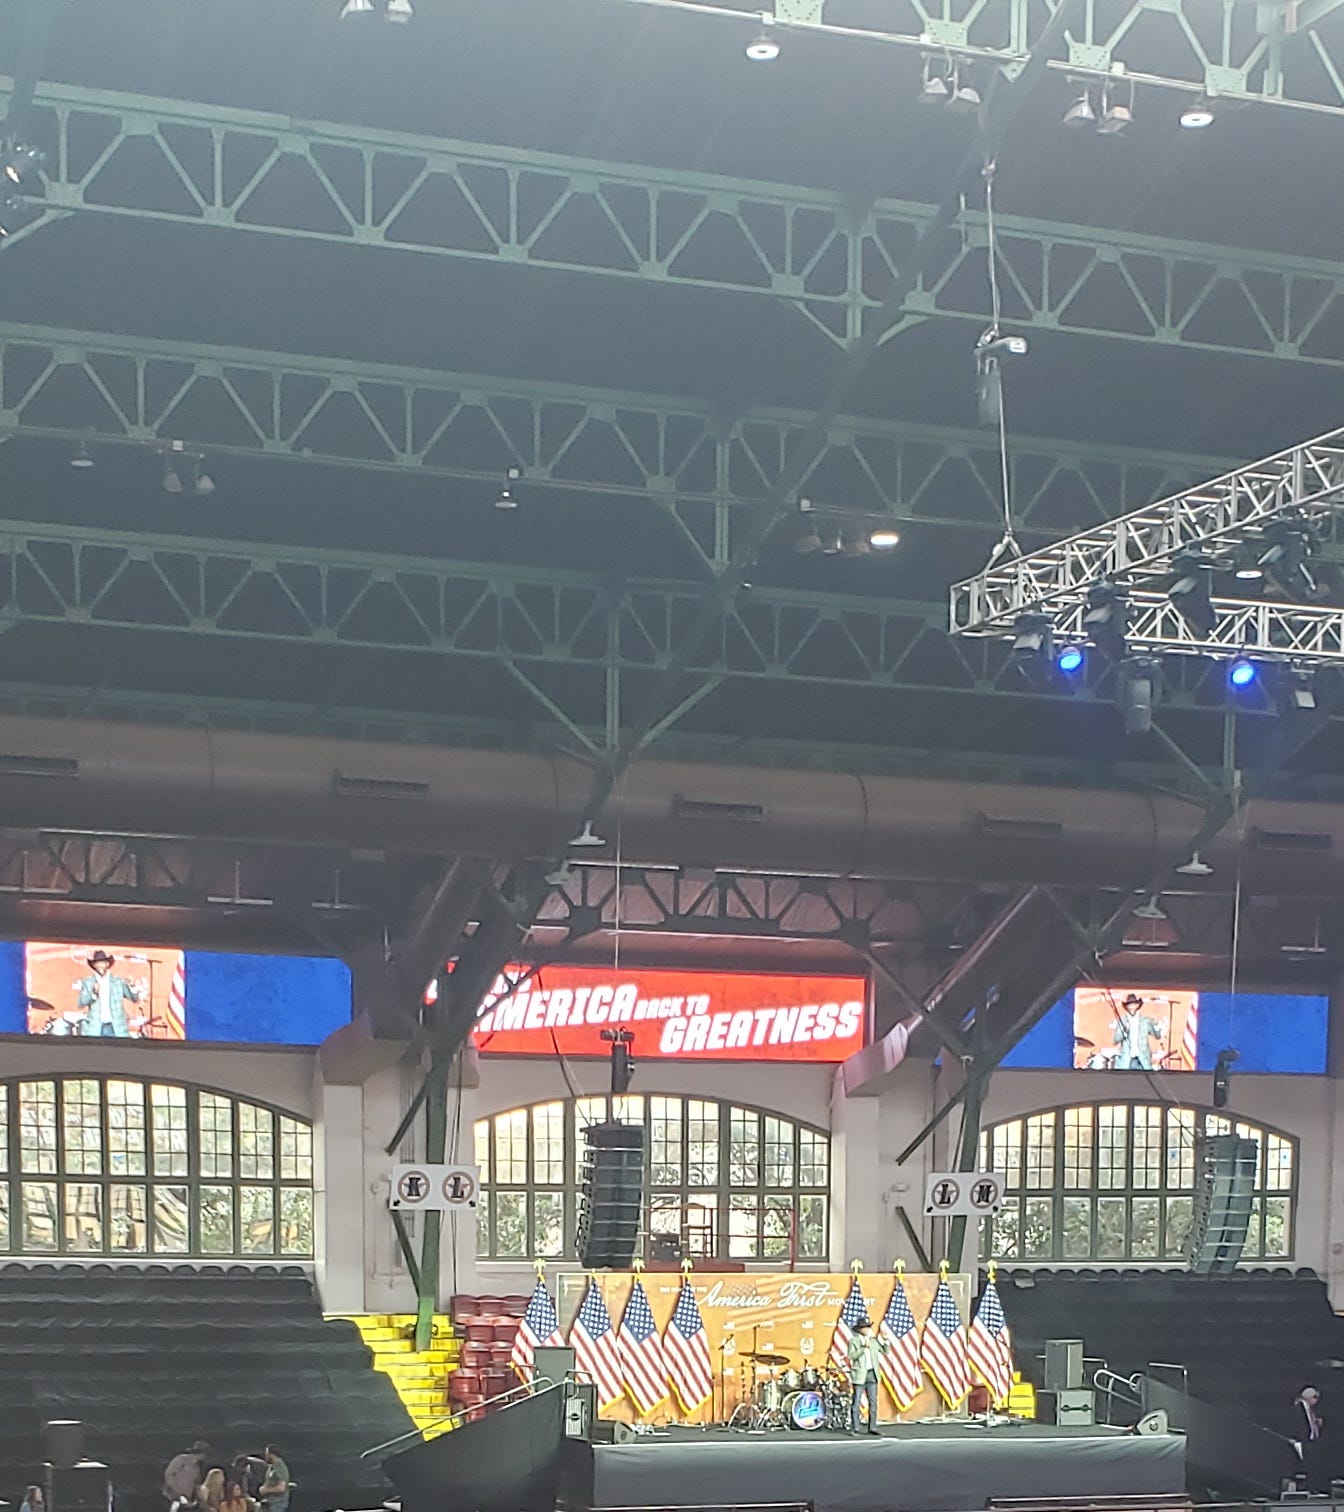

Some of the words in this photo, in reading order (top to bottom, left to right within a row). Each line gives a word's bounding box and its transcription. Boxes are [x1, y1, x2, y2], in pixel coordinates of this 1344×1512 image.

[635, 996, 684, 1020] BACK
[685, 994, 710, 1014] TO
[660, 1001, 862, 1053] GREATNESS
[451, 1177, 465, 1199] L
[939, 1184, 951, 1204] L
[700, 1280, 772, 1308] America
[777, 1281, 839, 1308] First
